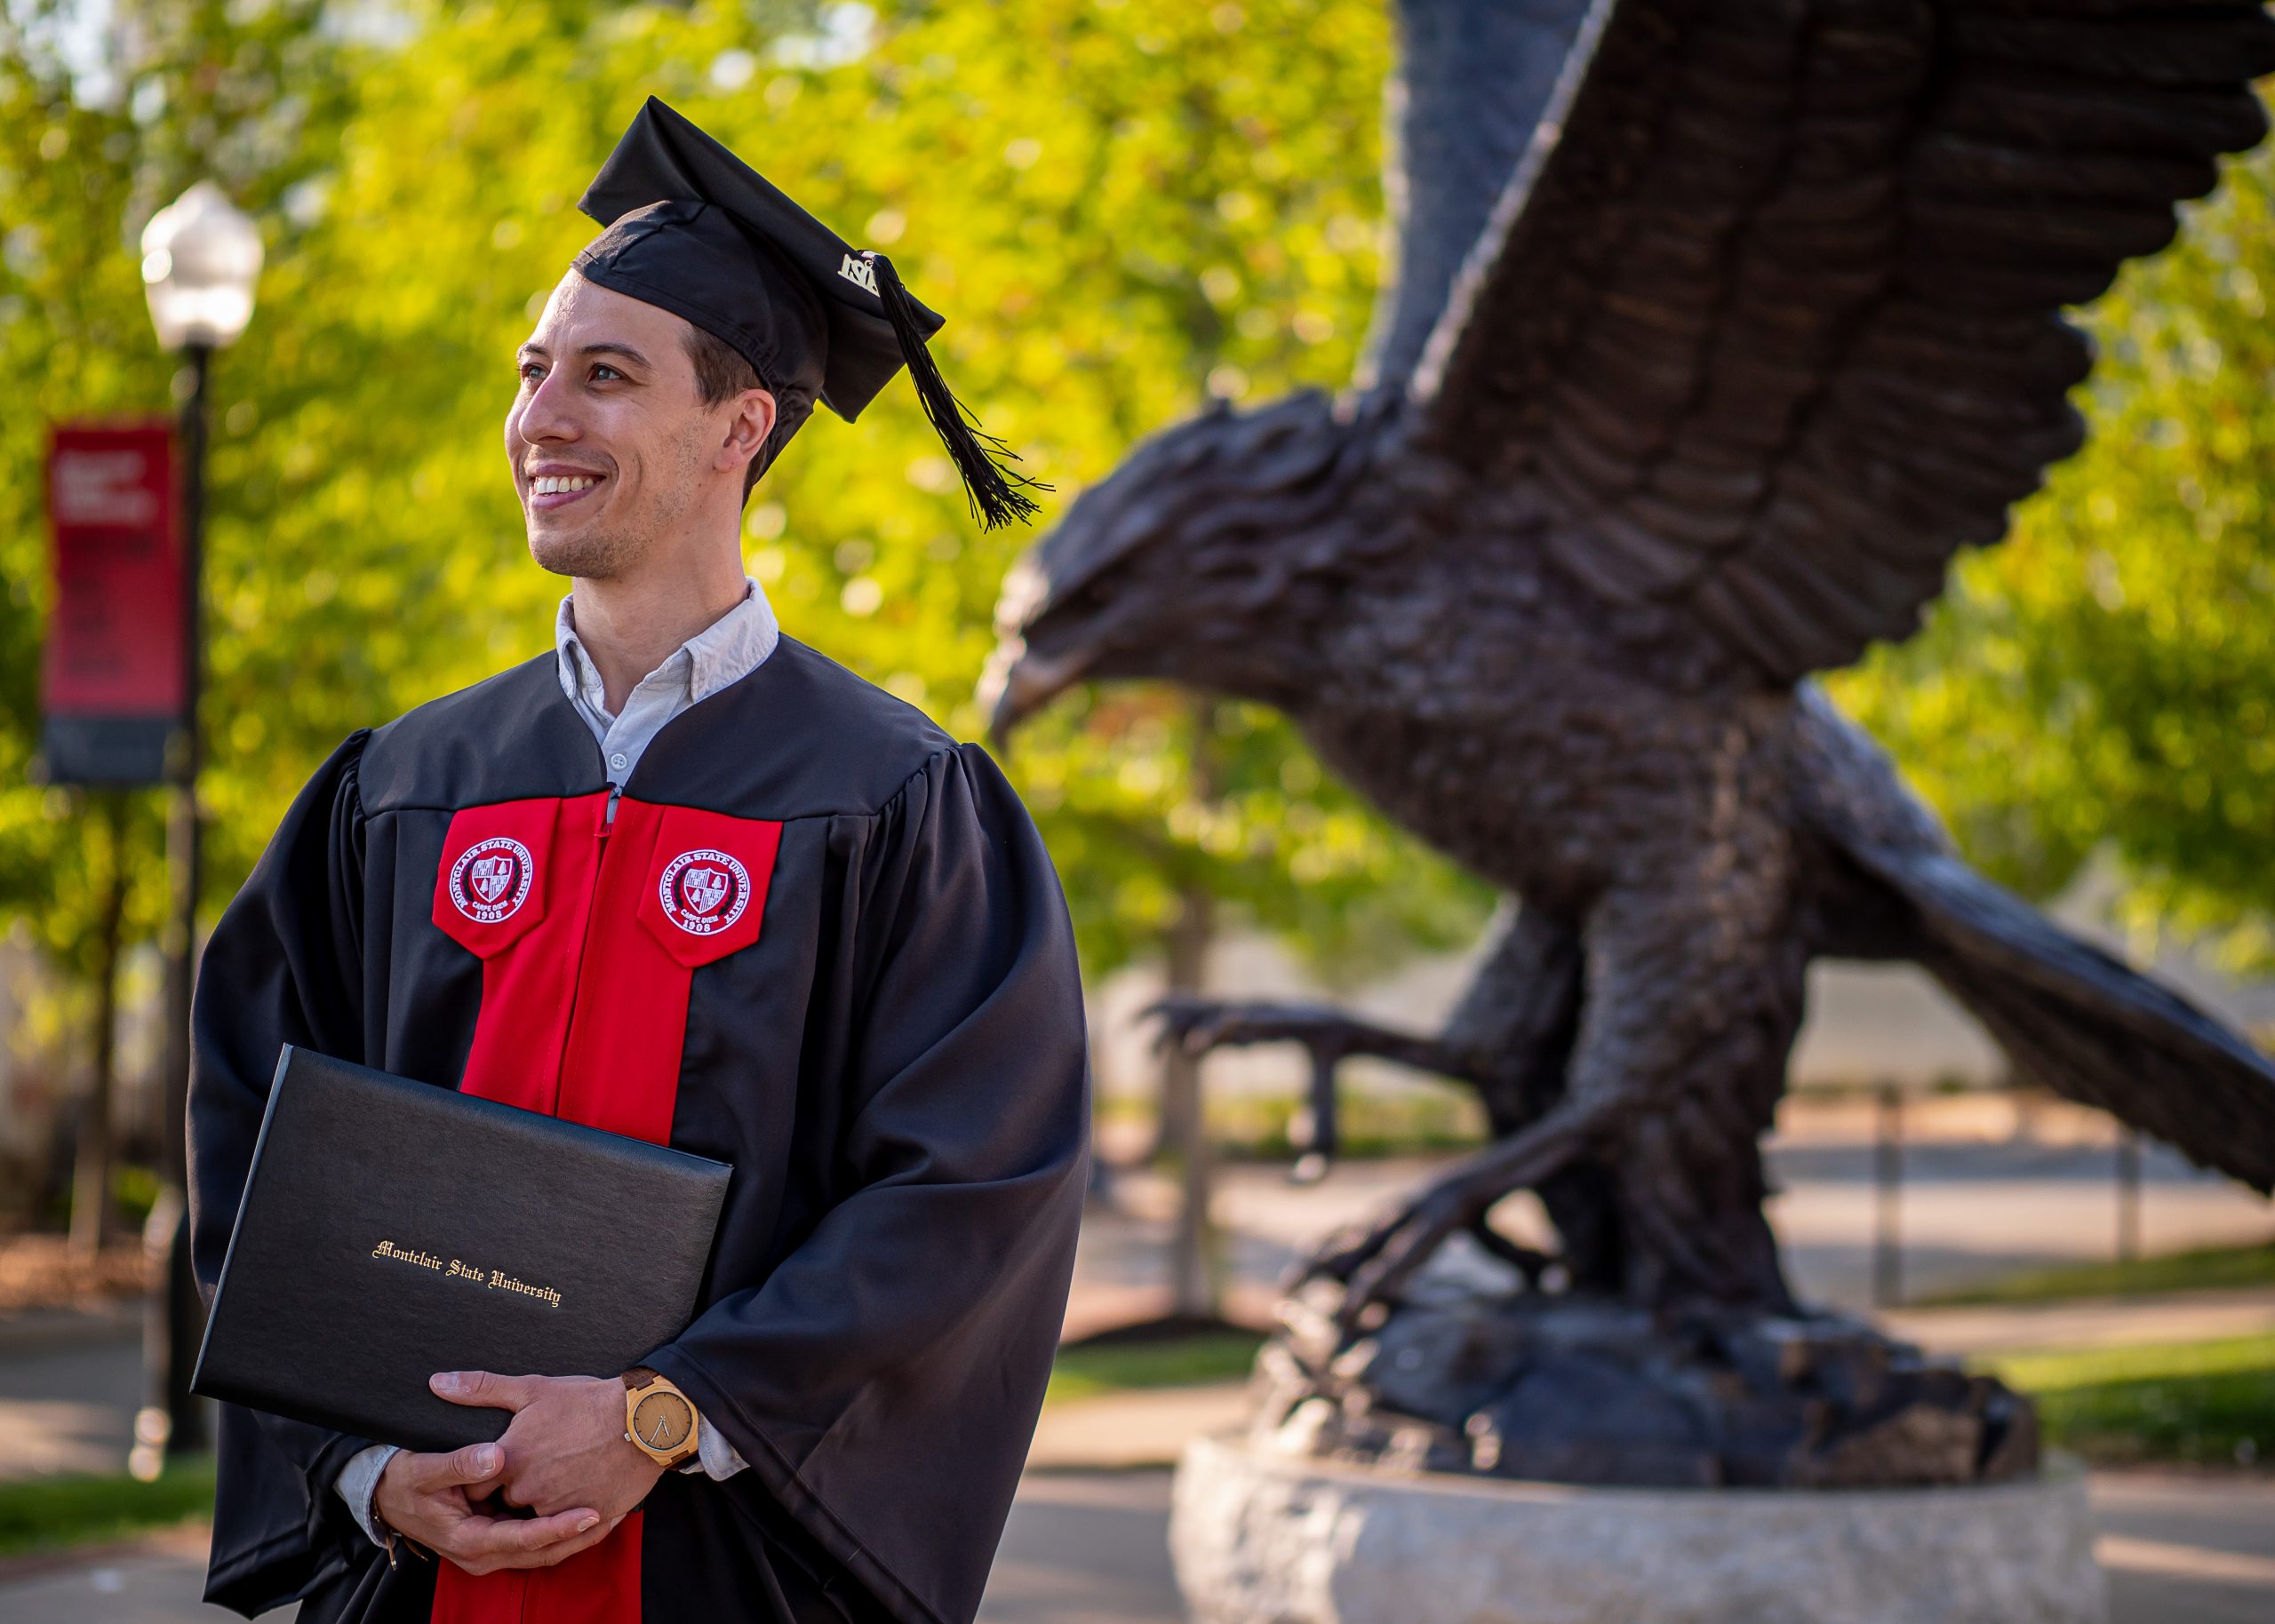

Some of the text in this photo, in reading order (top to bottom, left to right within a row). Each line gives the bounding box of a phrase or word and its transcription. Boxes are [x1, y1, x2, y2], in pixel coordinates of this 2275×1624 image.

[452, 840, 530, 909] MONTCLAIR STATE UNIVERSITY
[662, 853, 747, 924] MONTCLAIR STATE UNIVERSITY
[475, 911, 502, 920] 1908
[682, 919, 711, 932] 1908
[372, 1240, 562, 1308] Montclair State University
